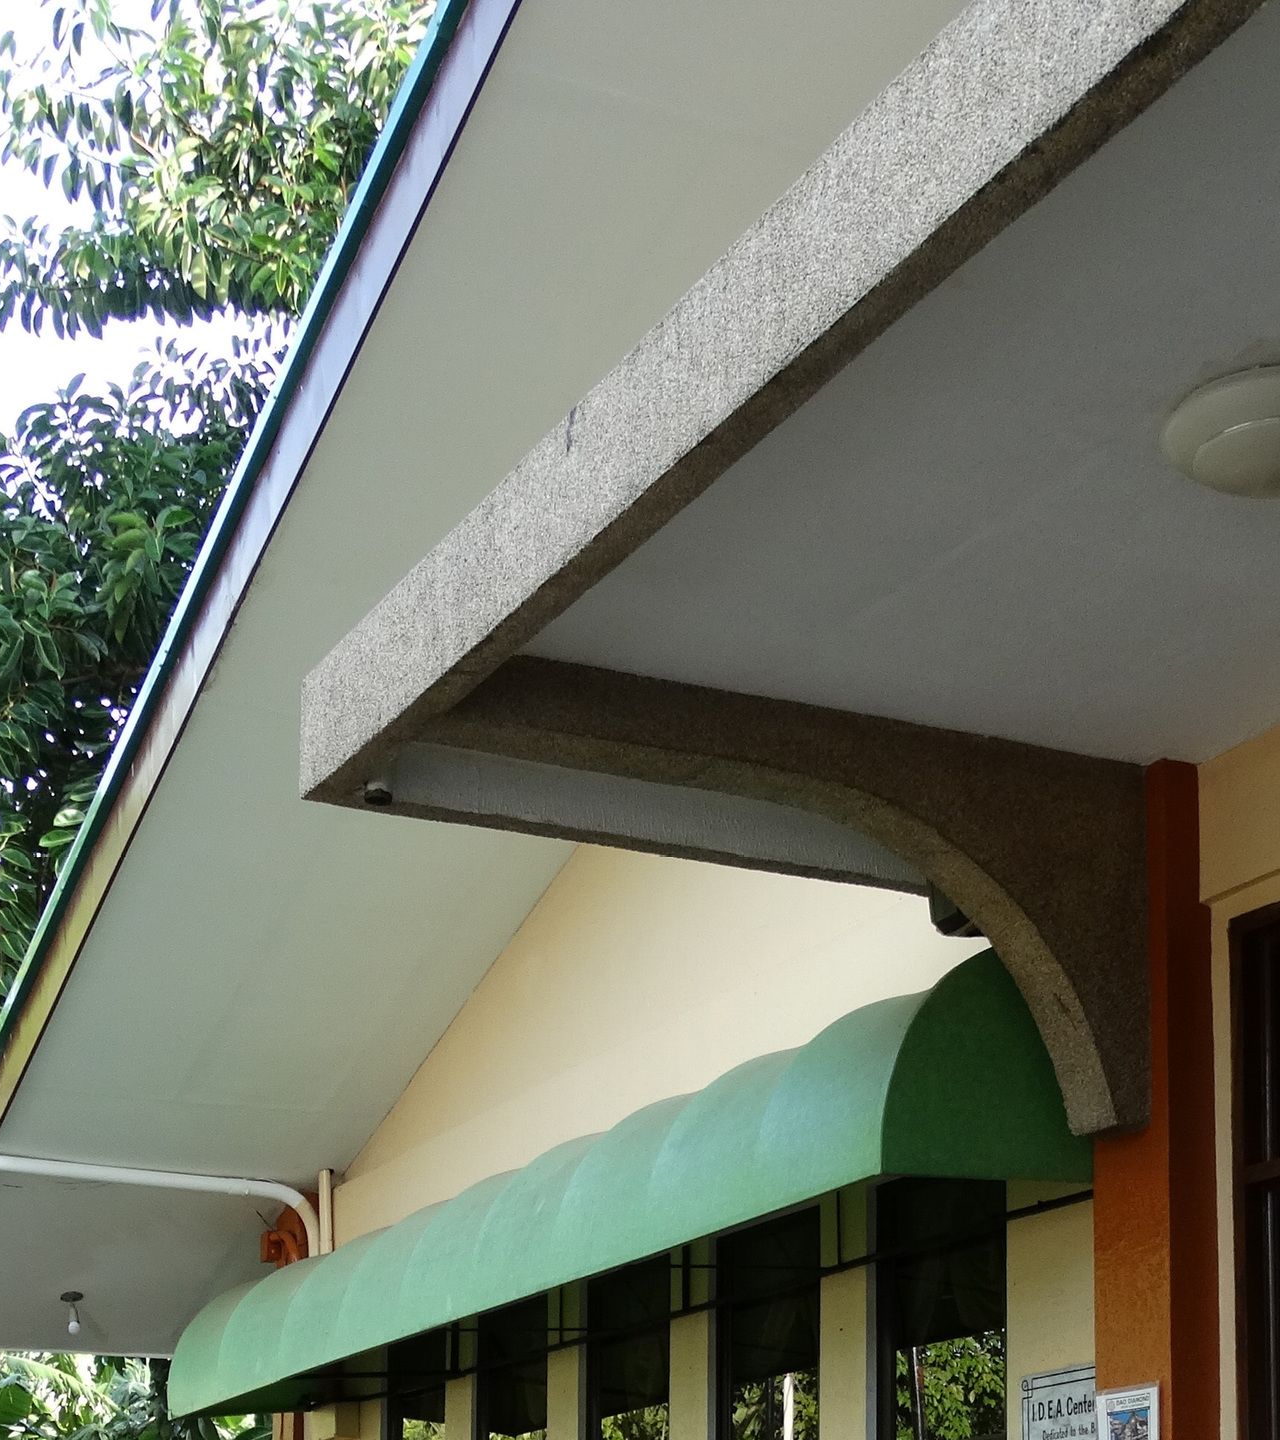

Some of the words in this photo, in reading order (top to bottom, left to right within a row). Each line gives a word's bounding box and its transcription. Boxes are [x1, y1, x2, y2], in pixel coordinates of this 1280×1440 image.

[1032, 1399, 1064, 1422] I.D.E.A.
[1042, 1426, 1068, 1440] Dedicated
[1070, 1426, 1076, 1437] to
[1078, 1424, 1088, 1435] the
